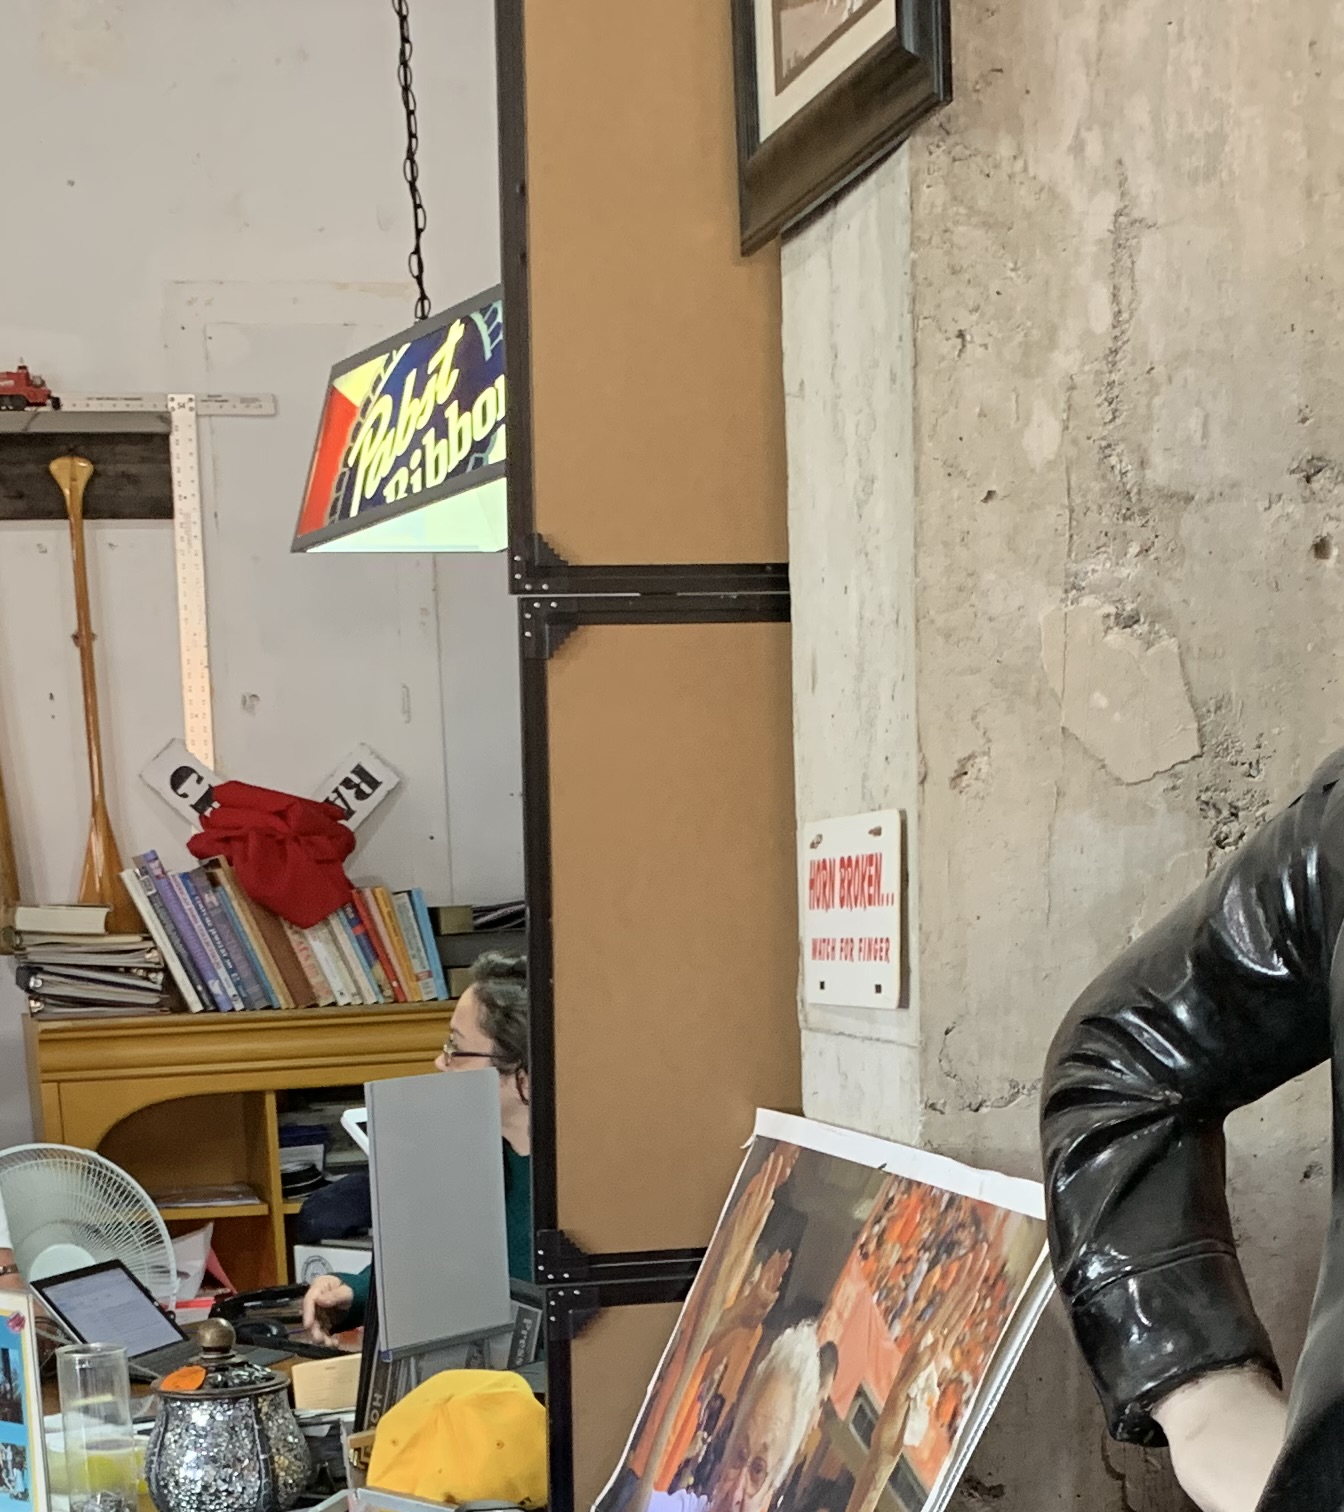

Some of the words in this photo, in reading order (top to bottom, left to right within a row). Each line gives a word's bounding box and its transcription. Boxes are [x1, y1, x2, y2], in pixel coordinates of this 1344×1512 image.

[348, 319, 465, 517] Pabst
[809, 857, 836, 912] HORN
[839, 852, 894, 912] BROKEN...
[811, 937, 837, 961] WATCH
[839, 937, 855, 962] FOR
[858, 937, 890, 963] FINGER
